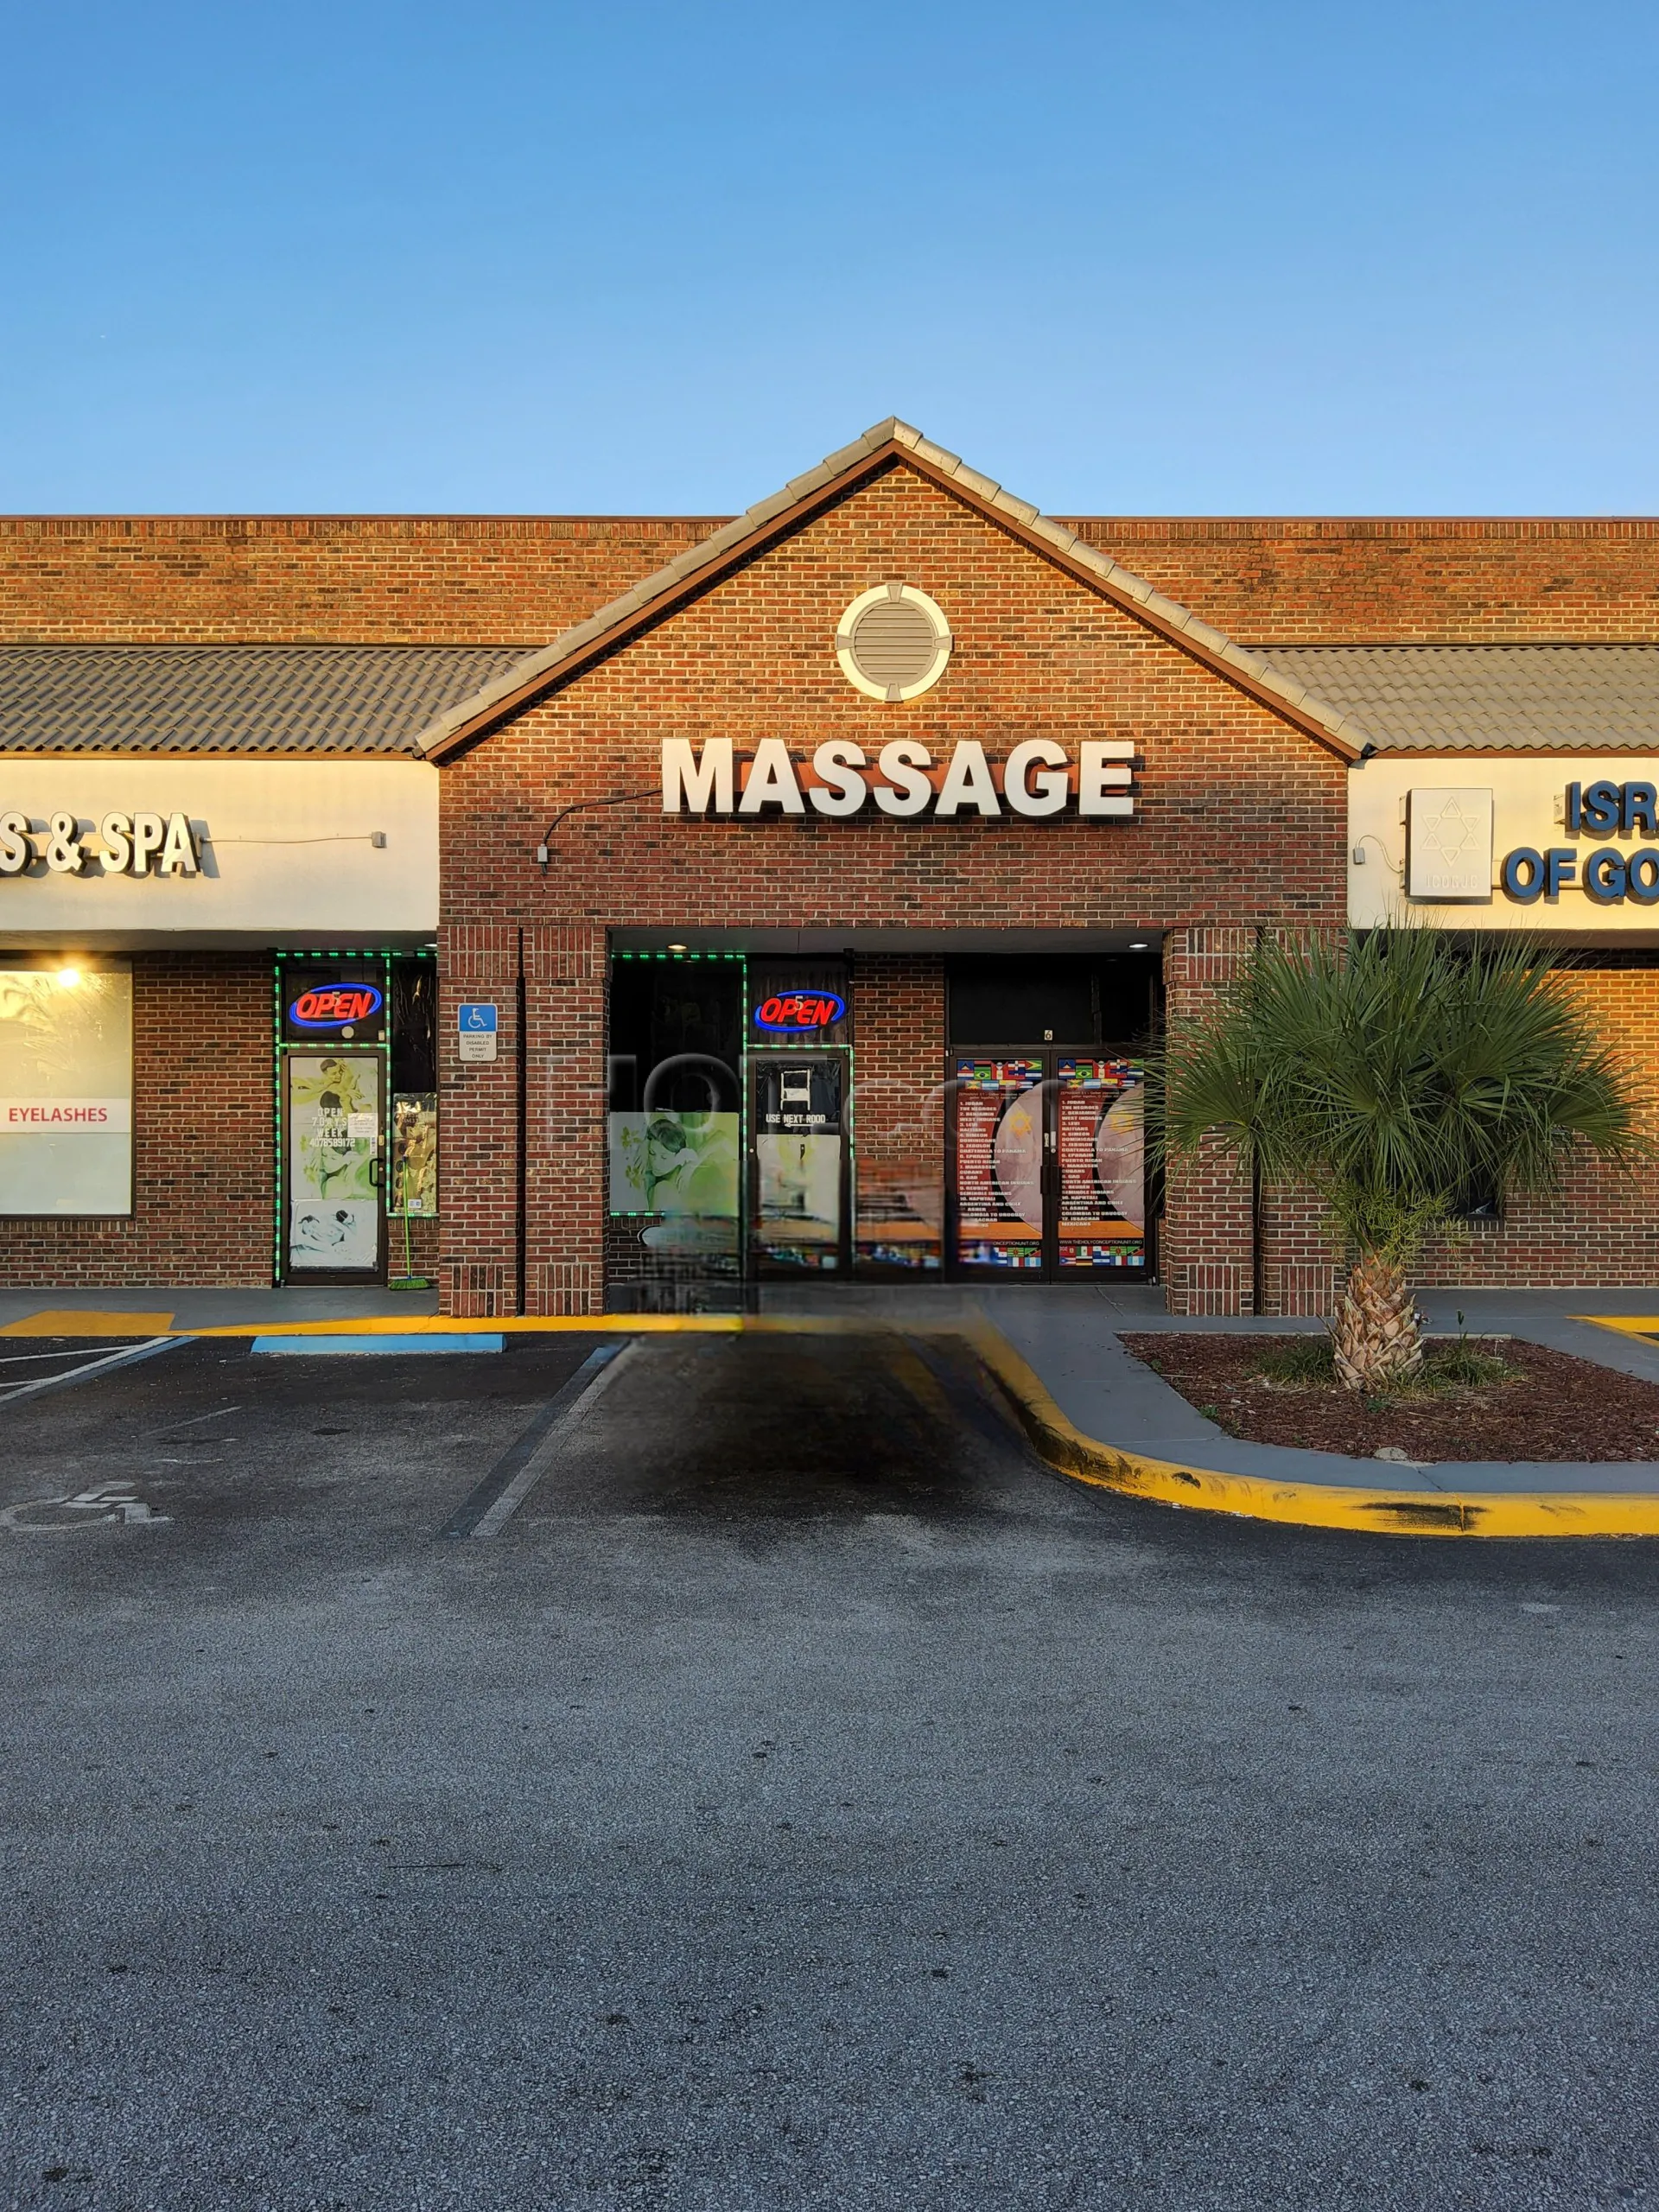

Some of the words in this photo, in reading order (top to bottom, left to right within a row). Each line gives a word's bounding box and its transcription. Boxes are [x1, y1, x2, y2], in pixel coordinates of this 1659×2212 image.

[662, 737, 1134, 817] MASSAGE
[46, 810, 83, 873] &
[99, 811, 198, 874] SPA
[1503, 846, 1578, 900] OF
[296, 993, 372, 1019] OPEN
[761, 997, 835, 1025] OPEN
[9, 1107, 108, 1122] EYELASHES
[317, 1108, 343, 1117] OPEN
[766, 1113, 781, 1123] USE
[783, 1114, 804, 1123] NEXT
[317, 1128, 343, 1137] WEEK
